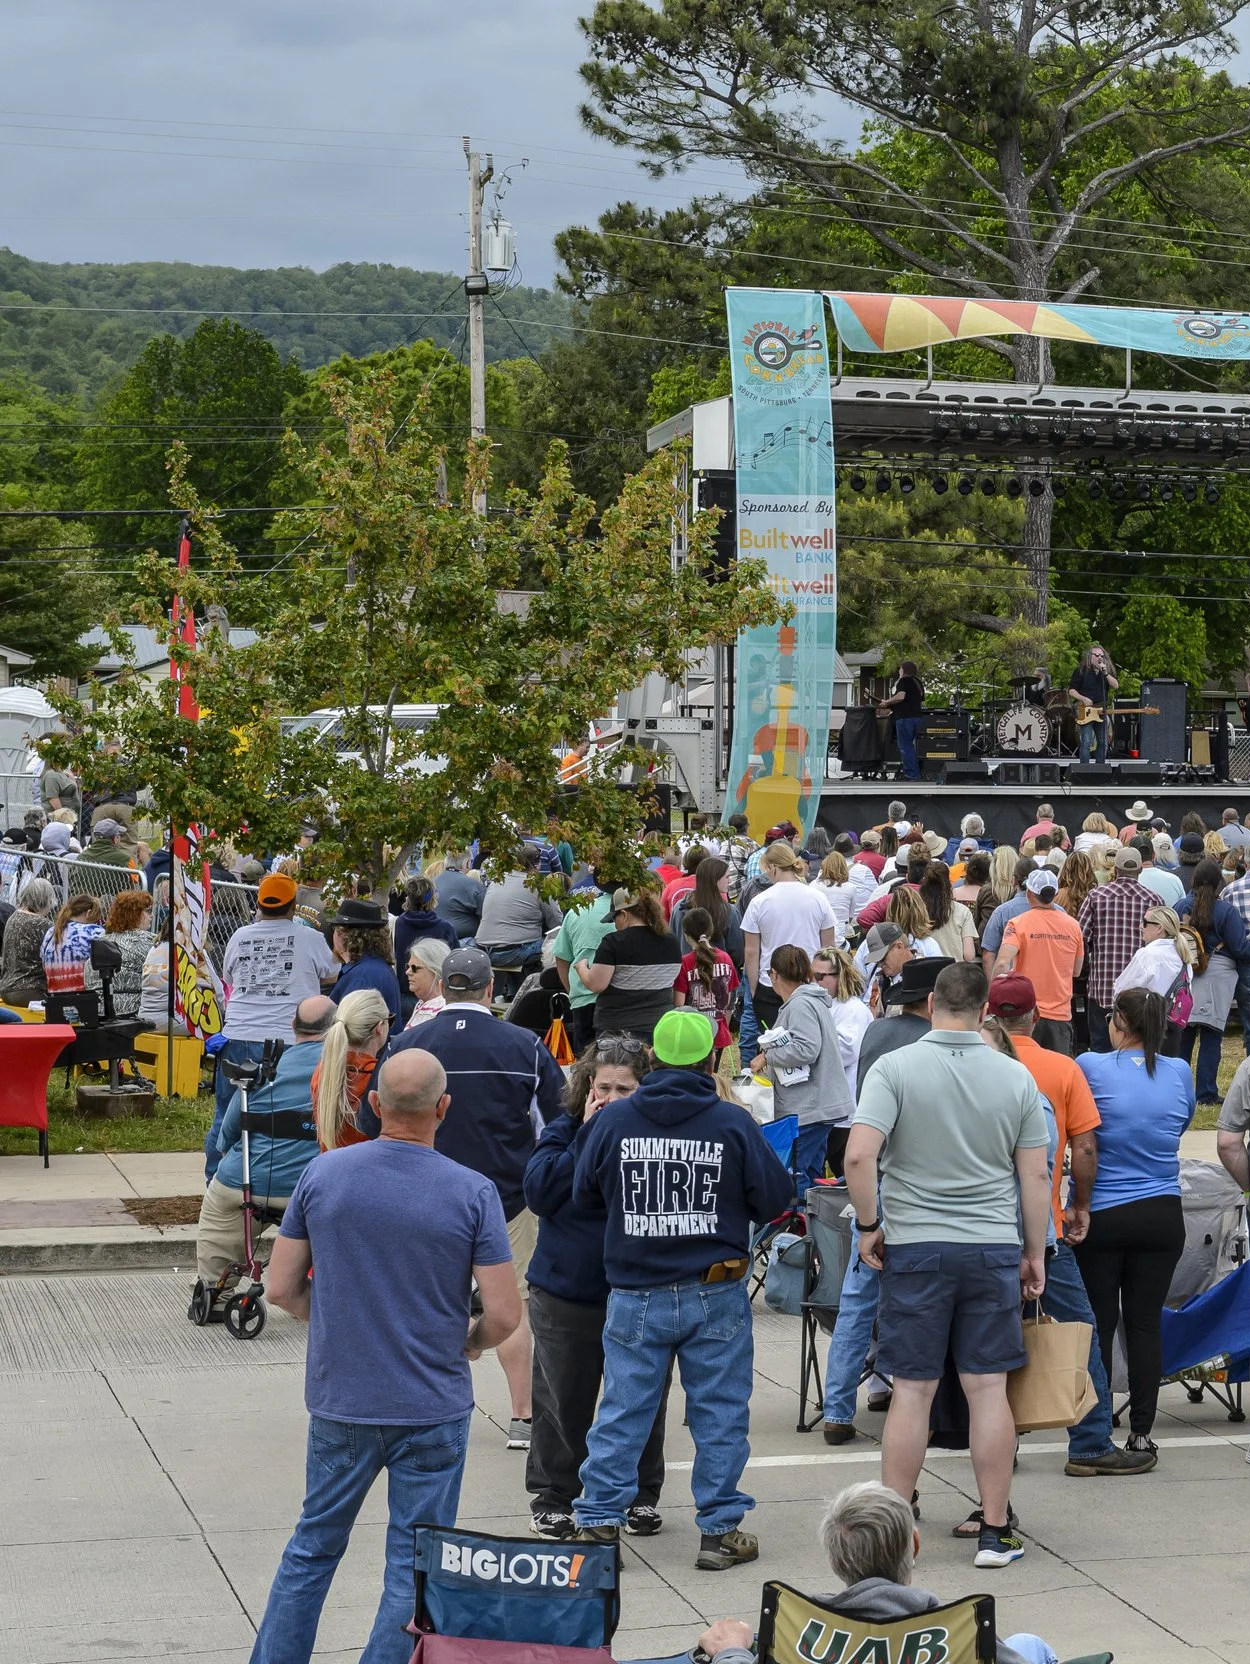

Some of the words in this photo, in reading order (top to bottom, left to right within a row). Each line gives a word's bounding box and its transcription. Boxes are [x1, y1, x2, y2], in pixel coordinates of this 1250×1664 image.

[742, 321, 797, 346] NATIONAL
[737, 385, 758, 401] SOUTH
[760, 397, 797, 407] PITTSBURG
[802, 367, 826, 397] TENNESSEE
[739, 499, 809, 516] Sponsored
[815, 500, 833, 516] By
[740, 528, 833, 549] Builtwell
[796, 552, 833, 564] BANK
[763, 573, 833, 595] iltwell
[777, 596, 833, 606] NSURANCE
[1014, 723, 1033, 740] M
[1029, 709, 1048, 742] COUNTY
[621, 1138, 724, 1163] SUMMITVILLE
[620, 1160, 721, 1215] FIRE
[624, 1214, 718, 1237] DEPARTMENT
[796, 1618, 949, 1664] UAB
